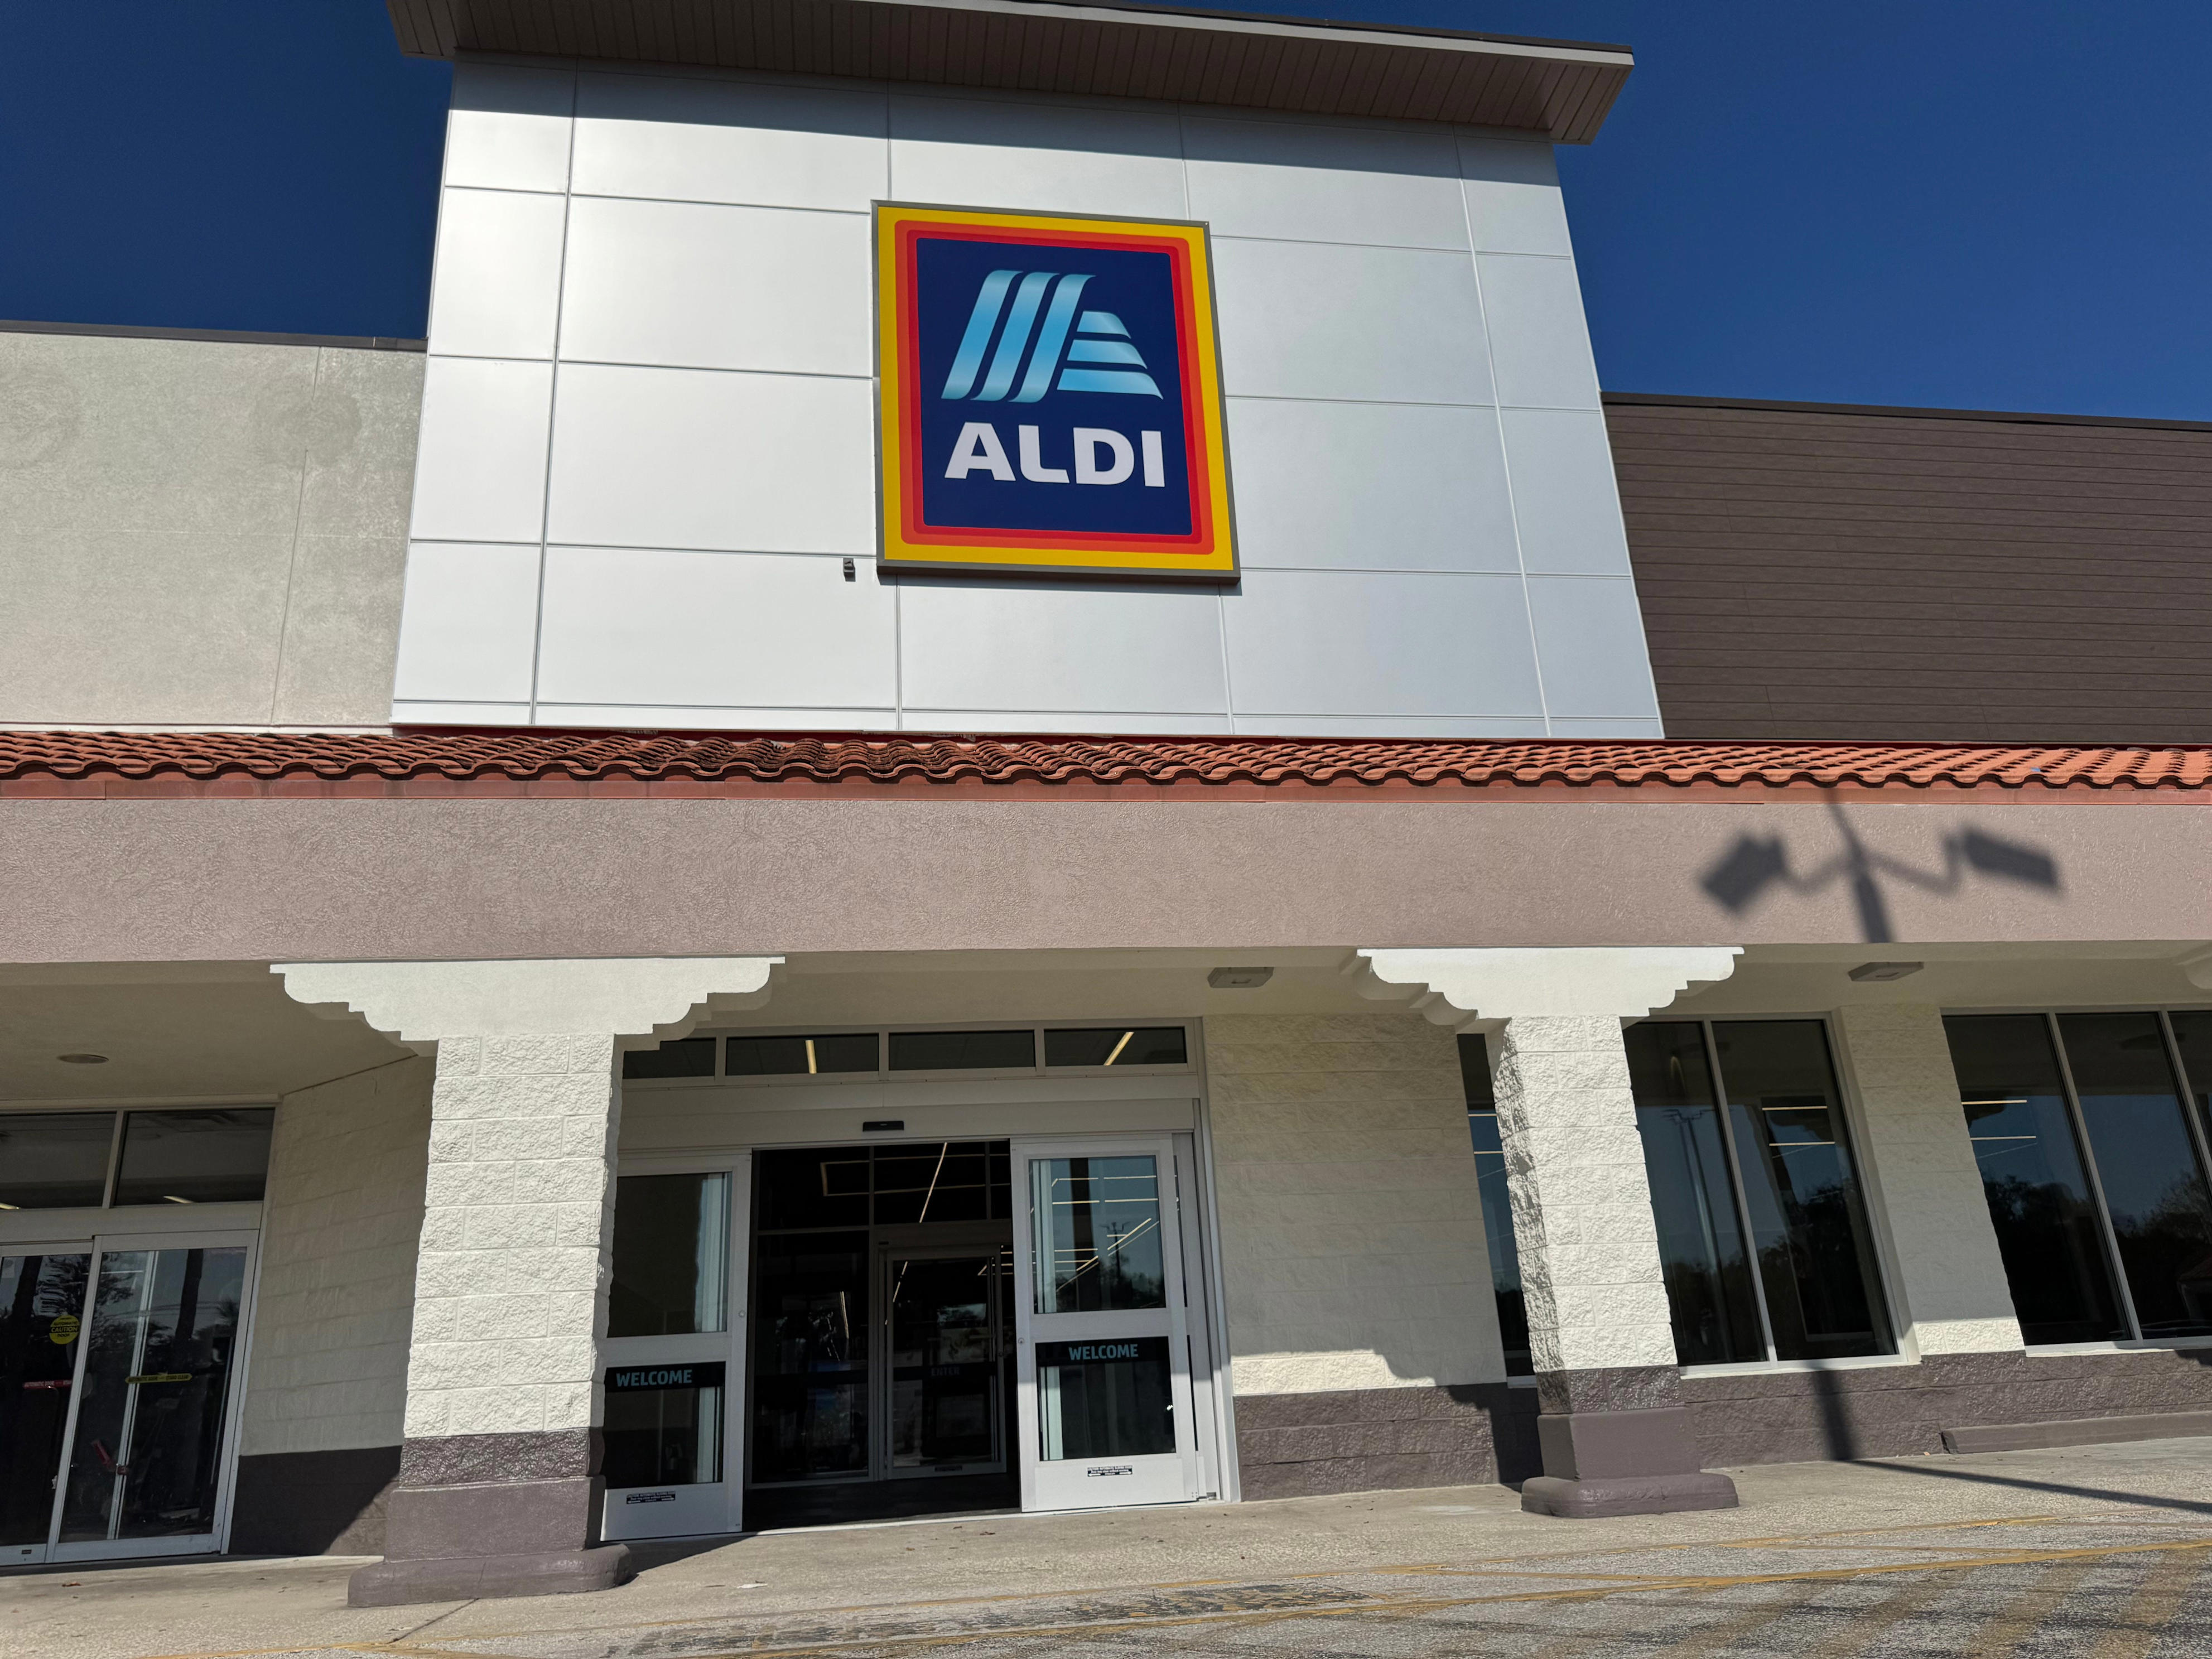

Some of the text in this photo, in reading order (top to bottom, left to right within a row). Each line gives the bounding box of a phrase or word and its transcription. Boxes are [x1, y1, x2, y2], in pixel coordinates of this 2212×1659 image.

[944, 422, 1165, 488] ALDI
[1068, 1344, 1139, 1361] WELCOME
[616, 1369, 692, 1387] WELCOME
[931, 1366, 960, 1376] ENTER
